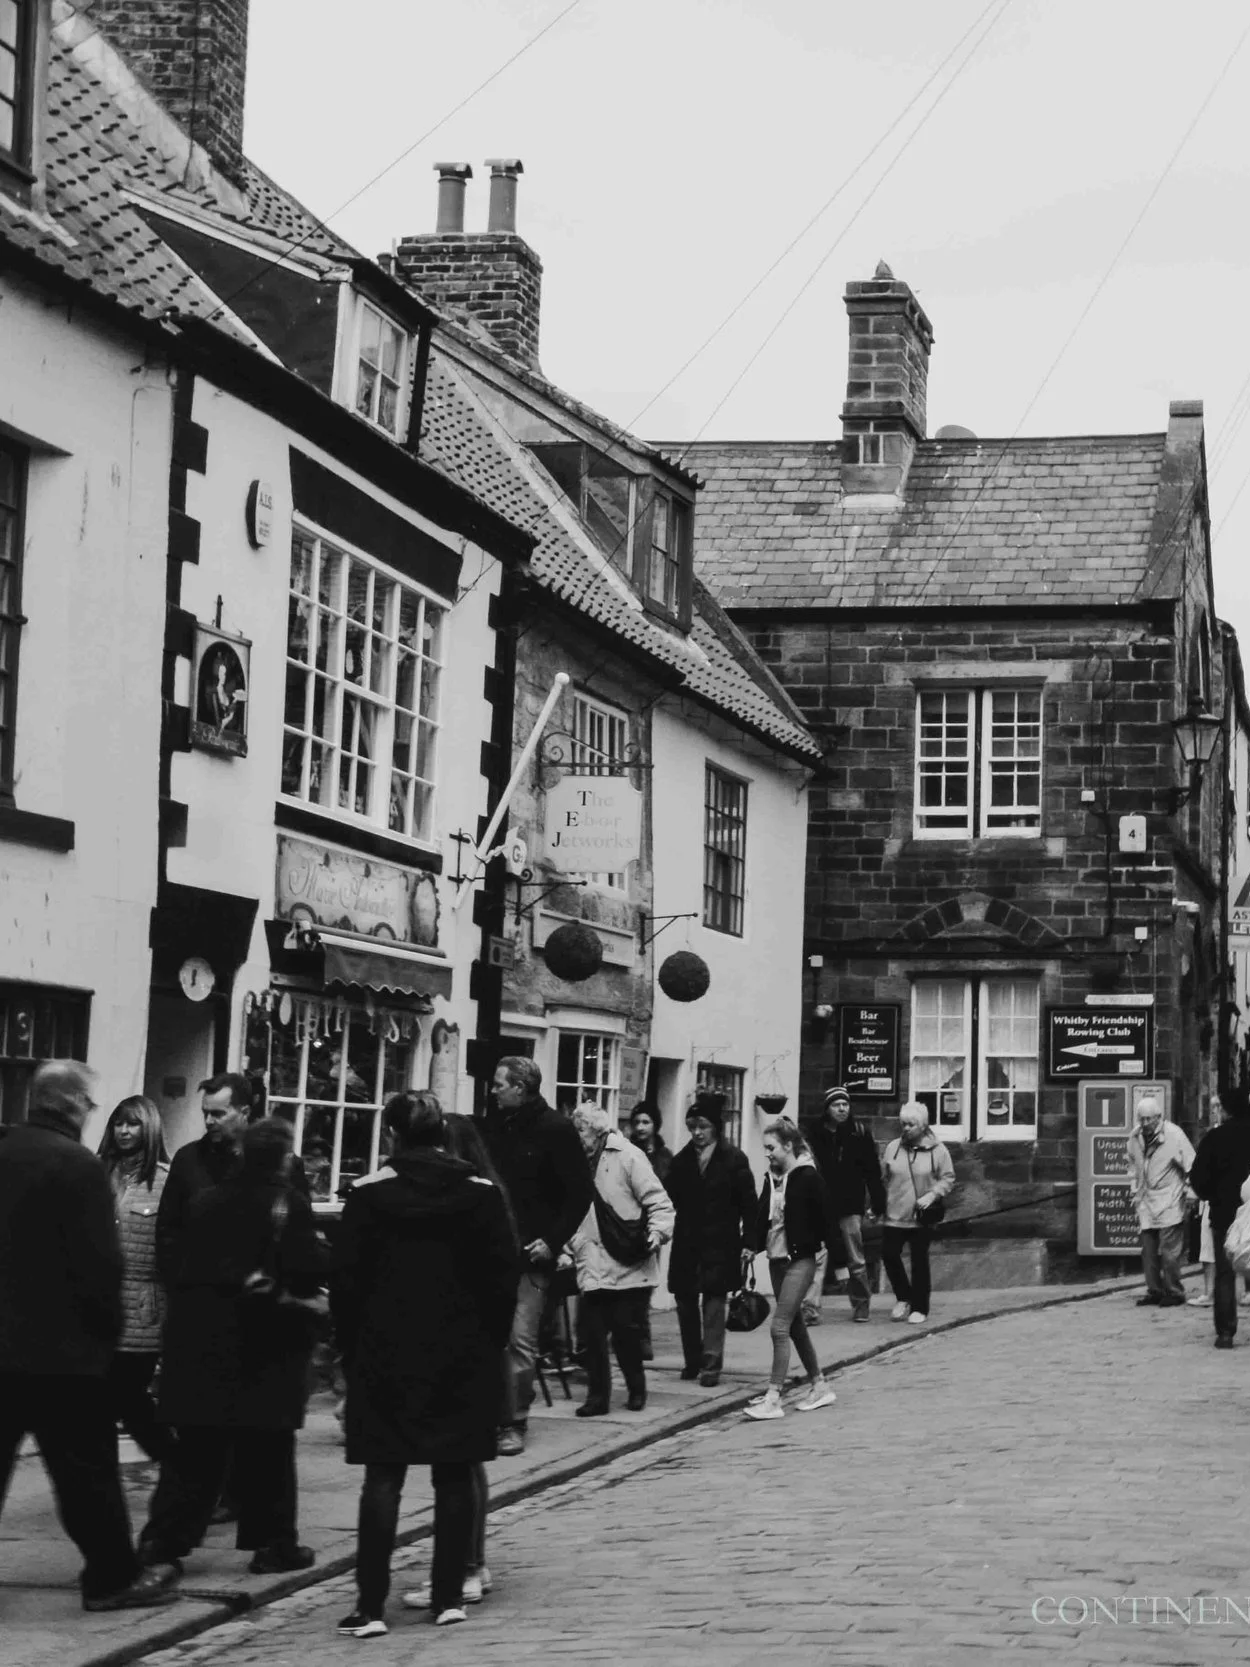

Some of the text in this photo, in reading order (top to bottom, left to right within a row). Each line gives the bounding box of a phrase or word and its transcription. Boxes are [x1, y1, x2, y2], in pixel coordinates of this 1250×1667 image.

[577, 790, 614, 807] The
[1128, 829, 1136, 839] 4
[551, 831, 634, 848] Jetworks
[860, 1010, 878, 1020] Bar
[1053, 1016, 1145, 1027] Whitby Friendship
[862, 1027, 876, 1035] Bar
[1067, 1027, 1131, 1039] Rowing Club
[848, 1037, 889, 1045] Boathouse
[856, 1052, 880, 1062] Beer
[848, 1064, 888, 1074] Garden
[1097, 1140, 1127, 1149] Unsui
[1104, 1151, 1118, 1160] for
[1105, 1162, 1129, 1171] vehic
[1100, 1188, 1122, 1197] Max
[1097, 1199, 1126, 1208] width
[1098, 1212, 1139, 1221] Restrict
[1106, 1224, 1141, 1235] turning
[1110, 1236, 1139, 1245] space
